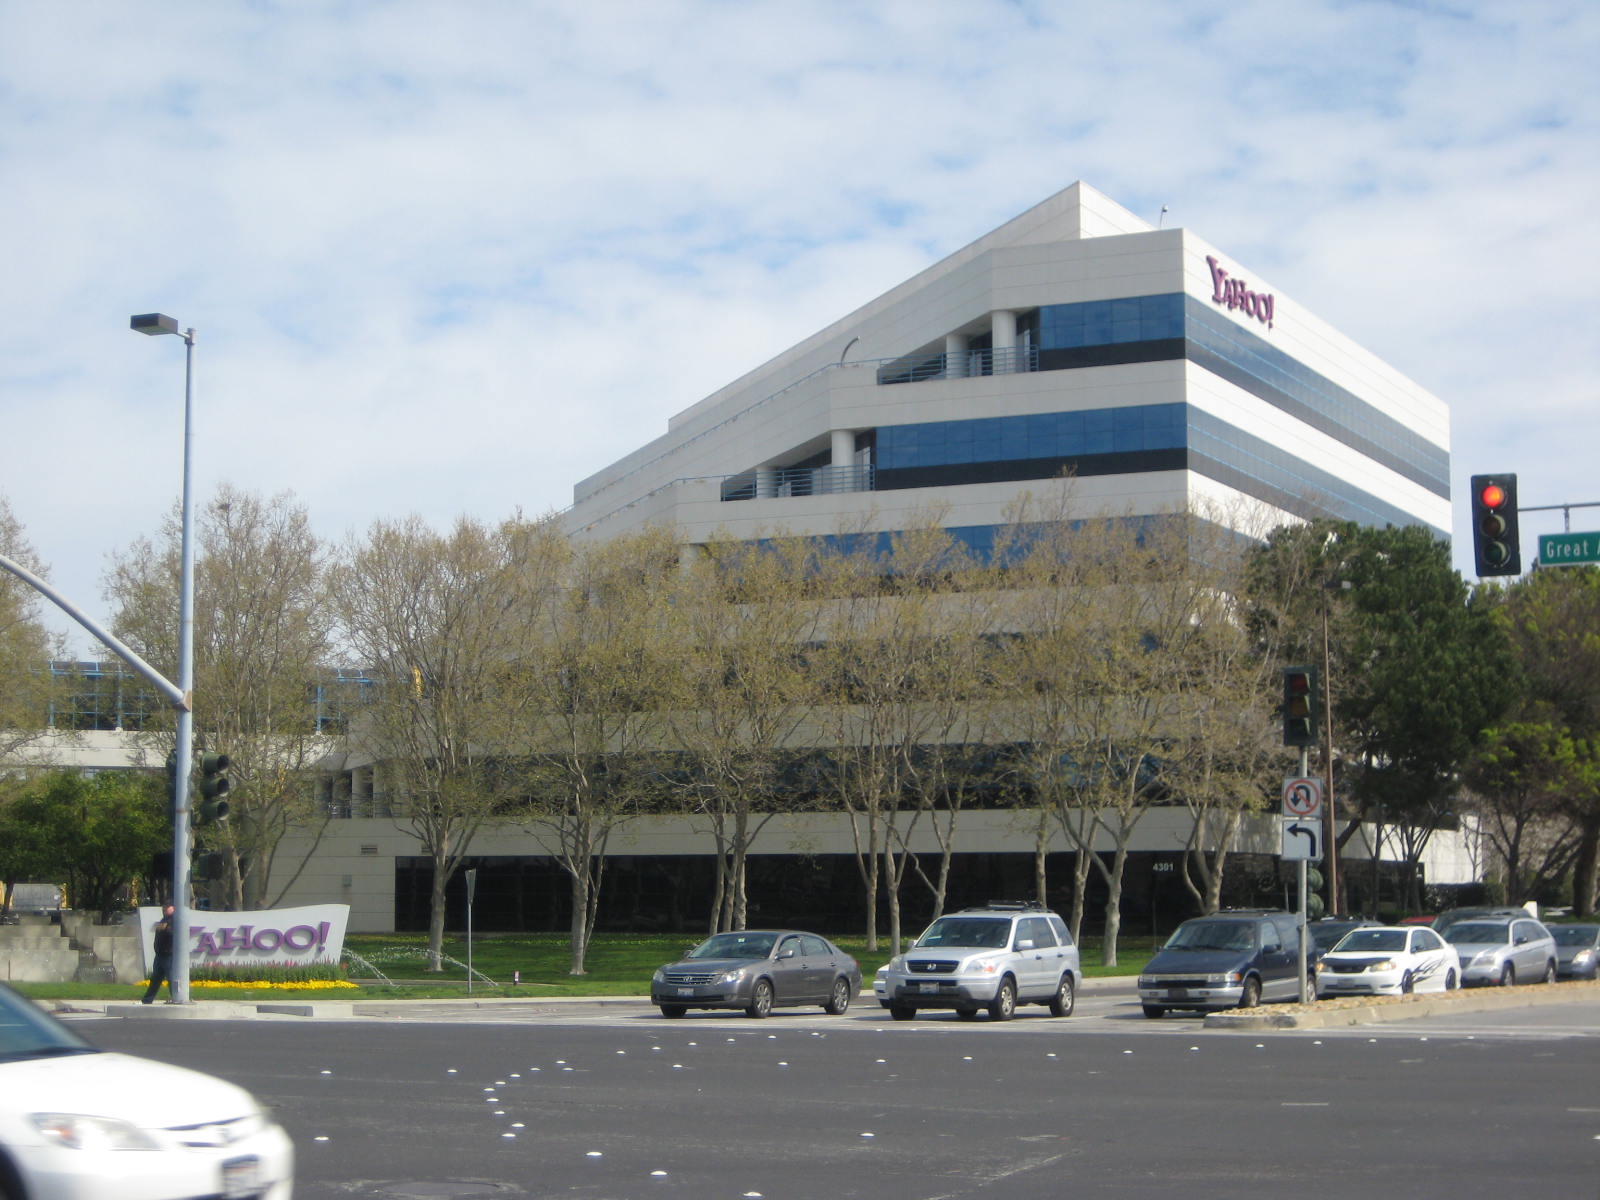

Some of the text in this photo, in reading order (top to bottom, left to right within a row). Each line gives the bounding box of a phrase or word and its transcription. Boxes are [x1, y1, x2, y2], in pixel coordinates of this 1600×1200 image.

[1206, 254, 1274, 330] YAHOO!
[1546, 540, 1589, 558] Great
[1152, 862, 1174, 872] 4301
